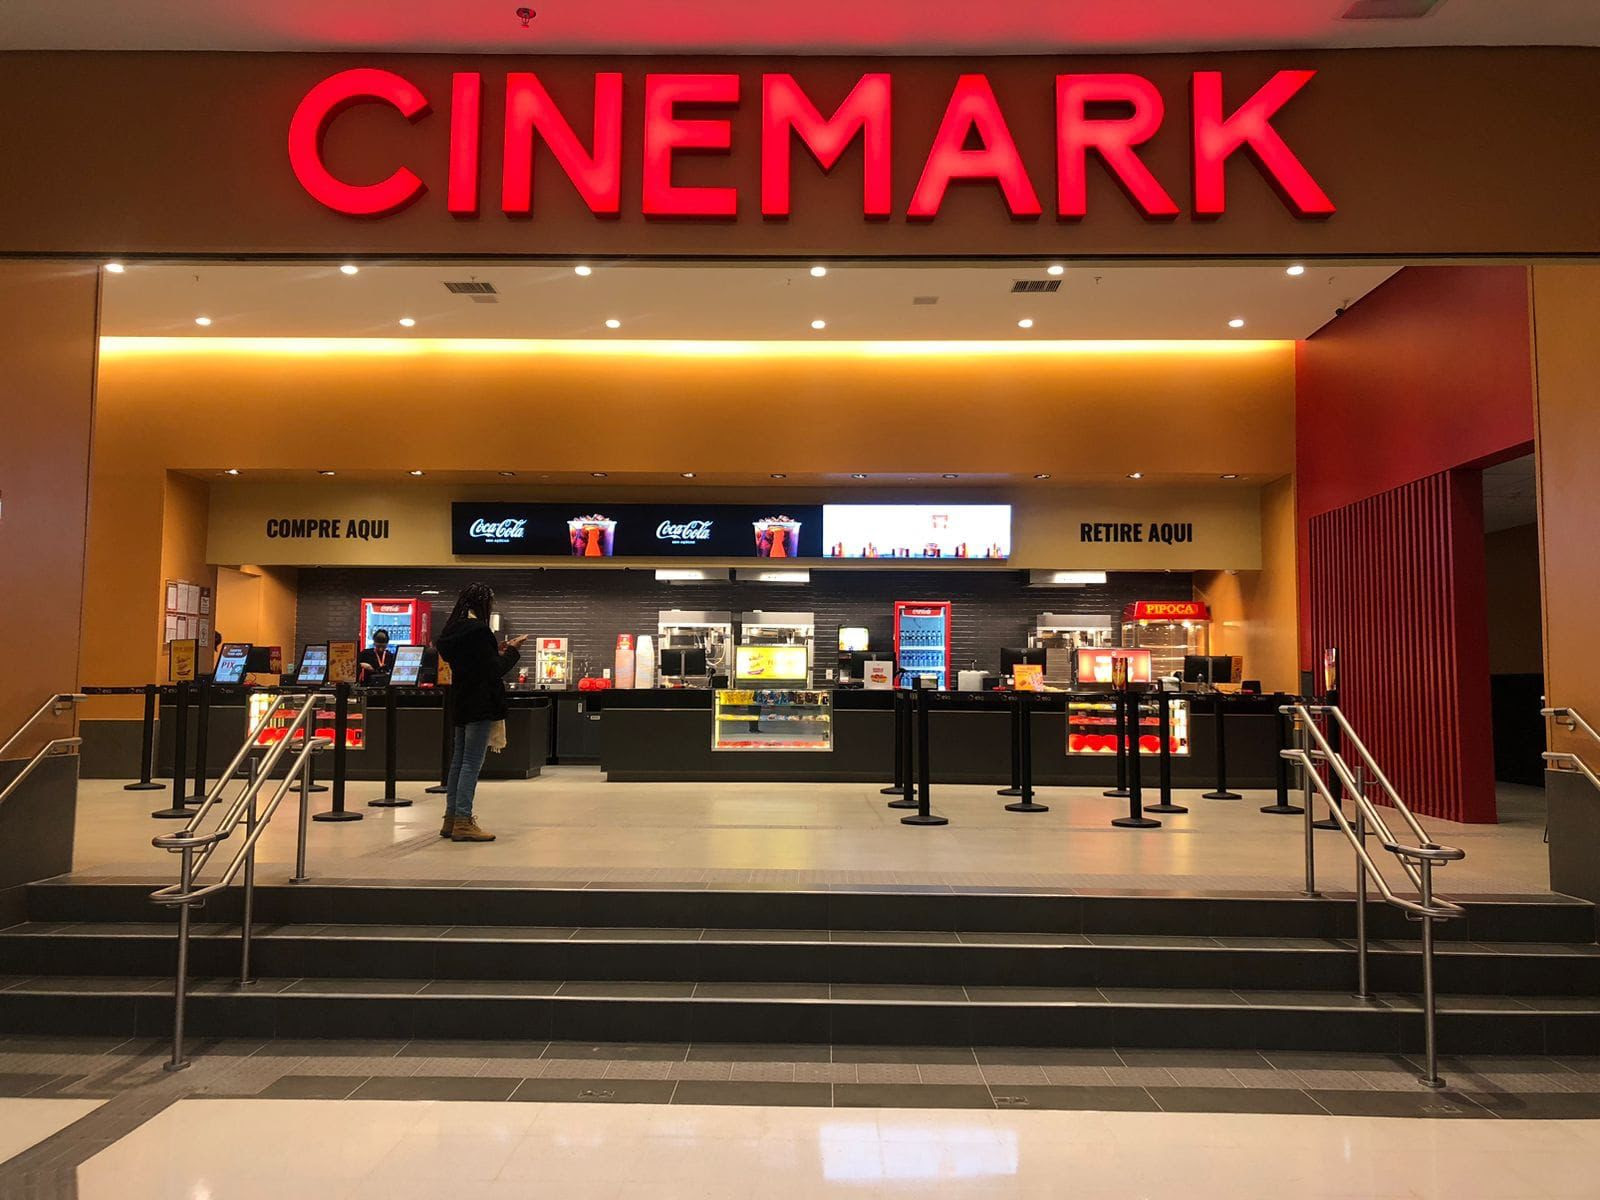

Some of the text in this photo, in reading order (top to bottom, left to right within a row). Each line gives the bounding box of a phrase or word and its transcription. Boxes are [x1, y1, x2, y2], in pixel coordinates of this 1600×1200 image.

[288, 68, 1336, 218] CINEMARK
[267, 519, 389, 541] COMPRE AQUI
[469, 518, 527, 538] Coca-Cola
[655, 520, 713, 539] Coca-Cola
[1080, 523, 1193, 545] RETIRE AQUI
[1146, 604, 1194, 614] PIPOCA
